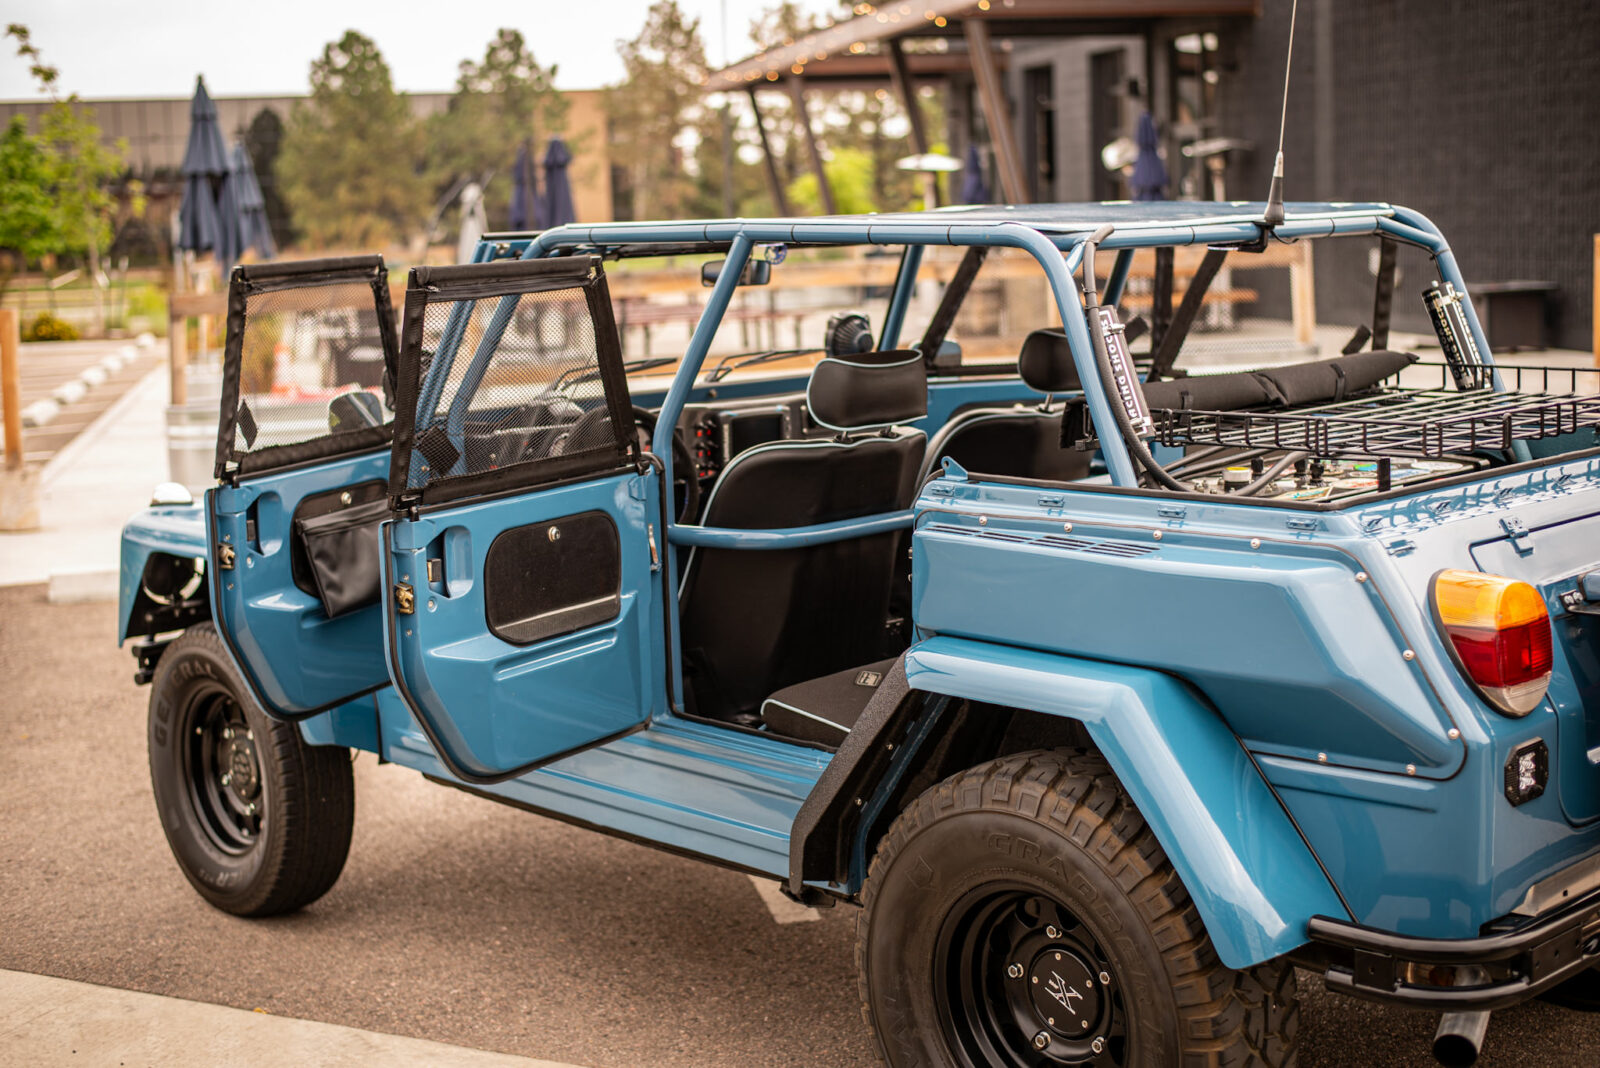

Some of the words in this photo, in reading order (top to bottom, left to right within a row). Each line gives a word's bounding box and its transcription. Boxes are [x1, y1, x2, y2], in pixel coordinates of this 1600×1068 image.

[1432, 300, 1453, 342] SHOC
[1101, 319, 1123, 372] SHOCS
[1118, 375, 1141, 421] ACING
